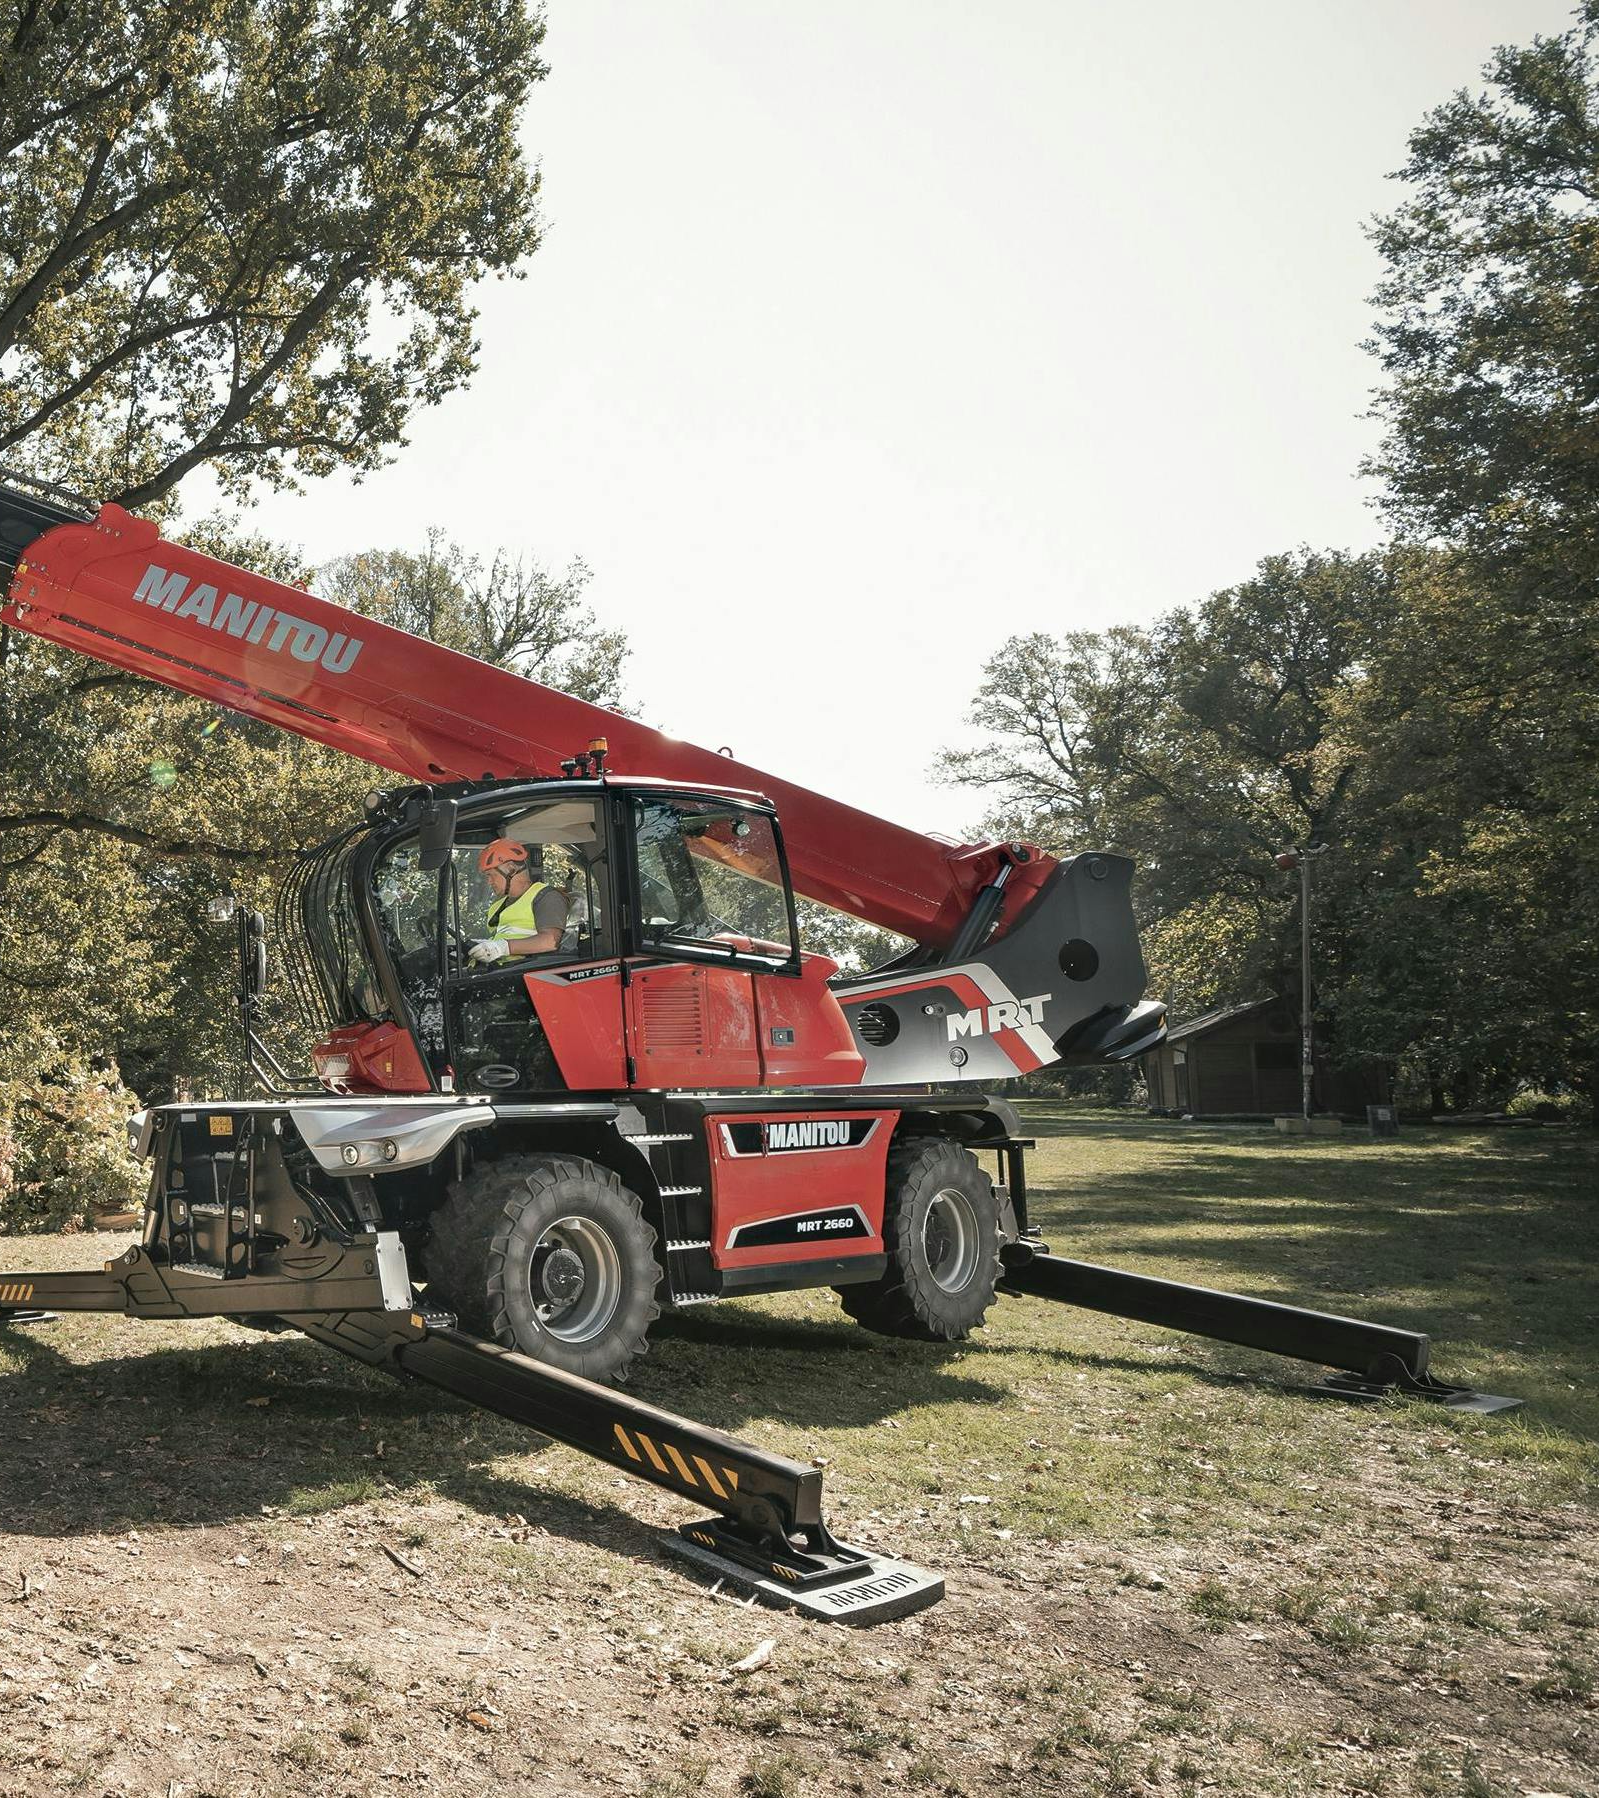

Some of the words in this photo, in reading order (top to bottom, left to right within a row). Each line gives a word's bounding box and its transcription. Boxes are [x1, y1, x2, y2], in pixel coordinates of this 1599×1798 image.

[132, 564, 364, 674] MANITOU
[569, 970, 591, 980] MRT
[593, 965, 619, 976] 2660
[946, 993, 1052, 1042] MRT
[769, 1121, 850, 1149] MANITOU
[797, 1221, 822, 1233] MRT
[823, 1218, 854, 1230] 2660
[818, 1572, 919, 1608] MANITOU
